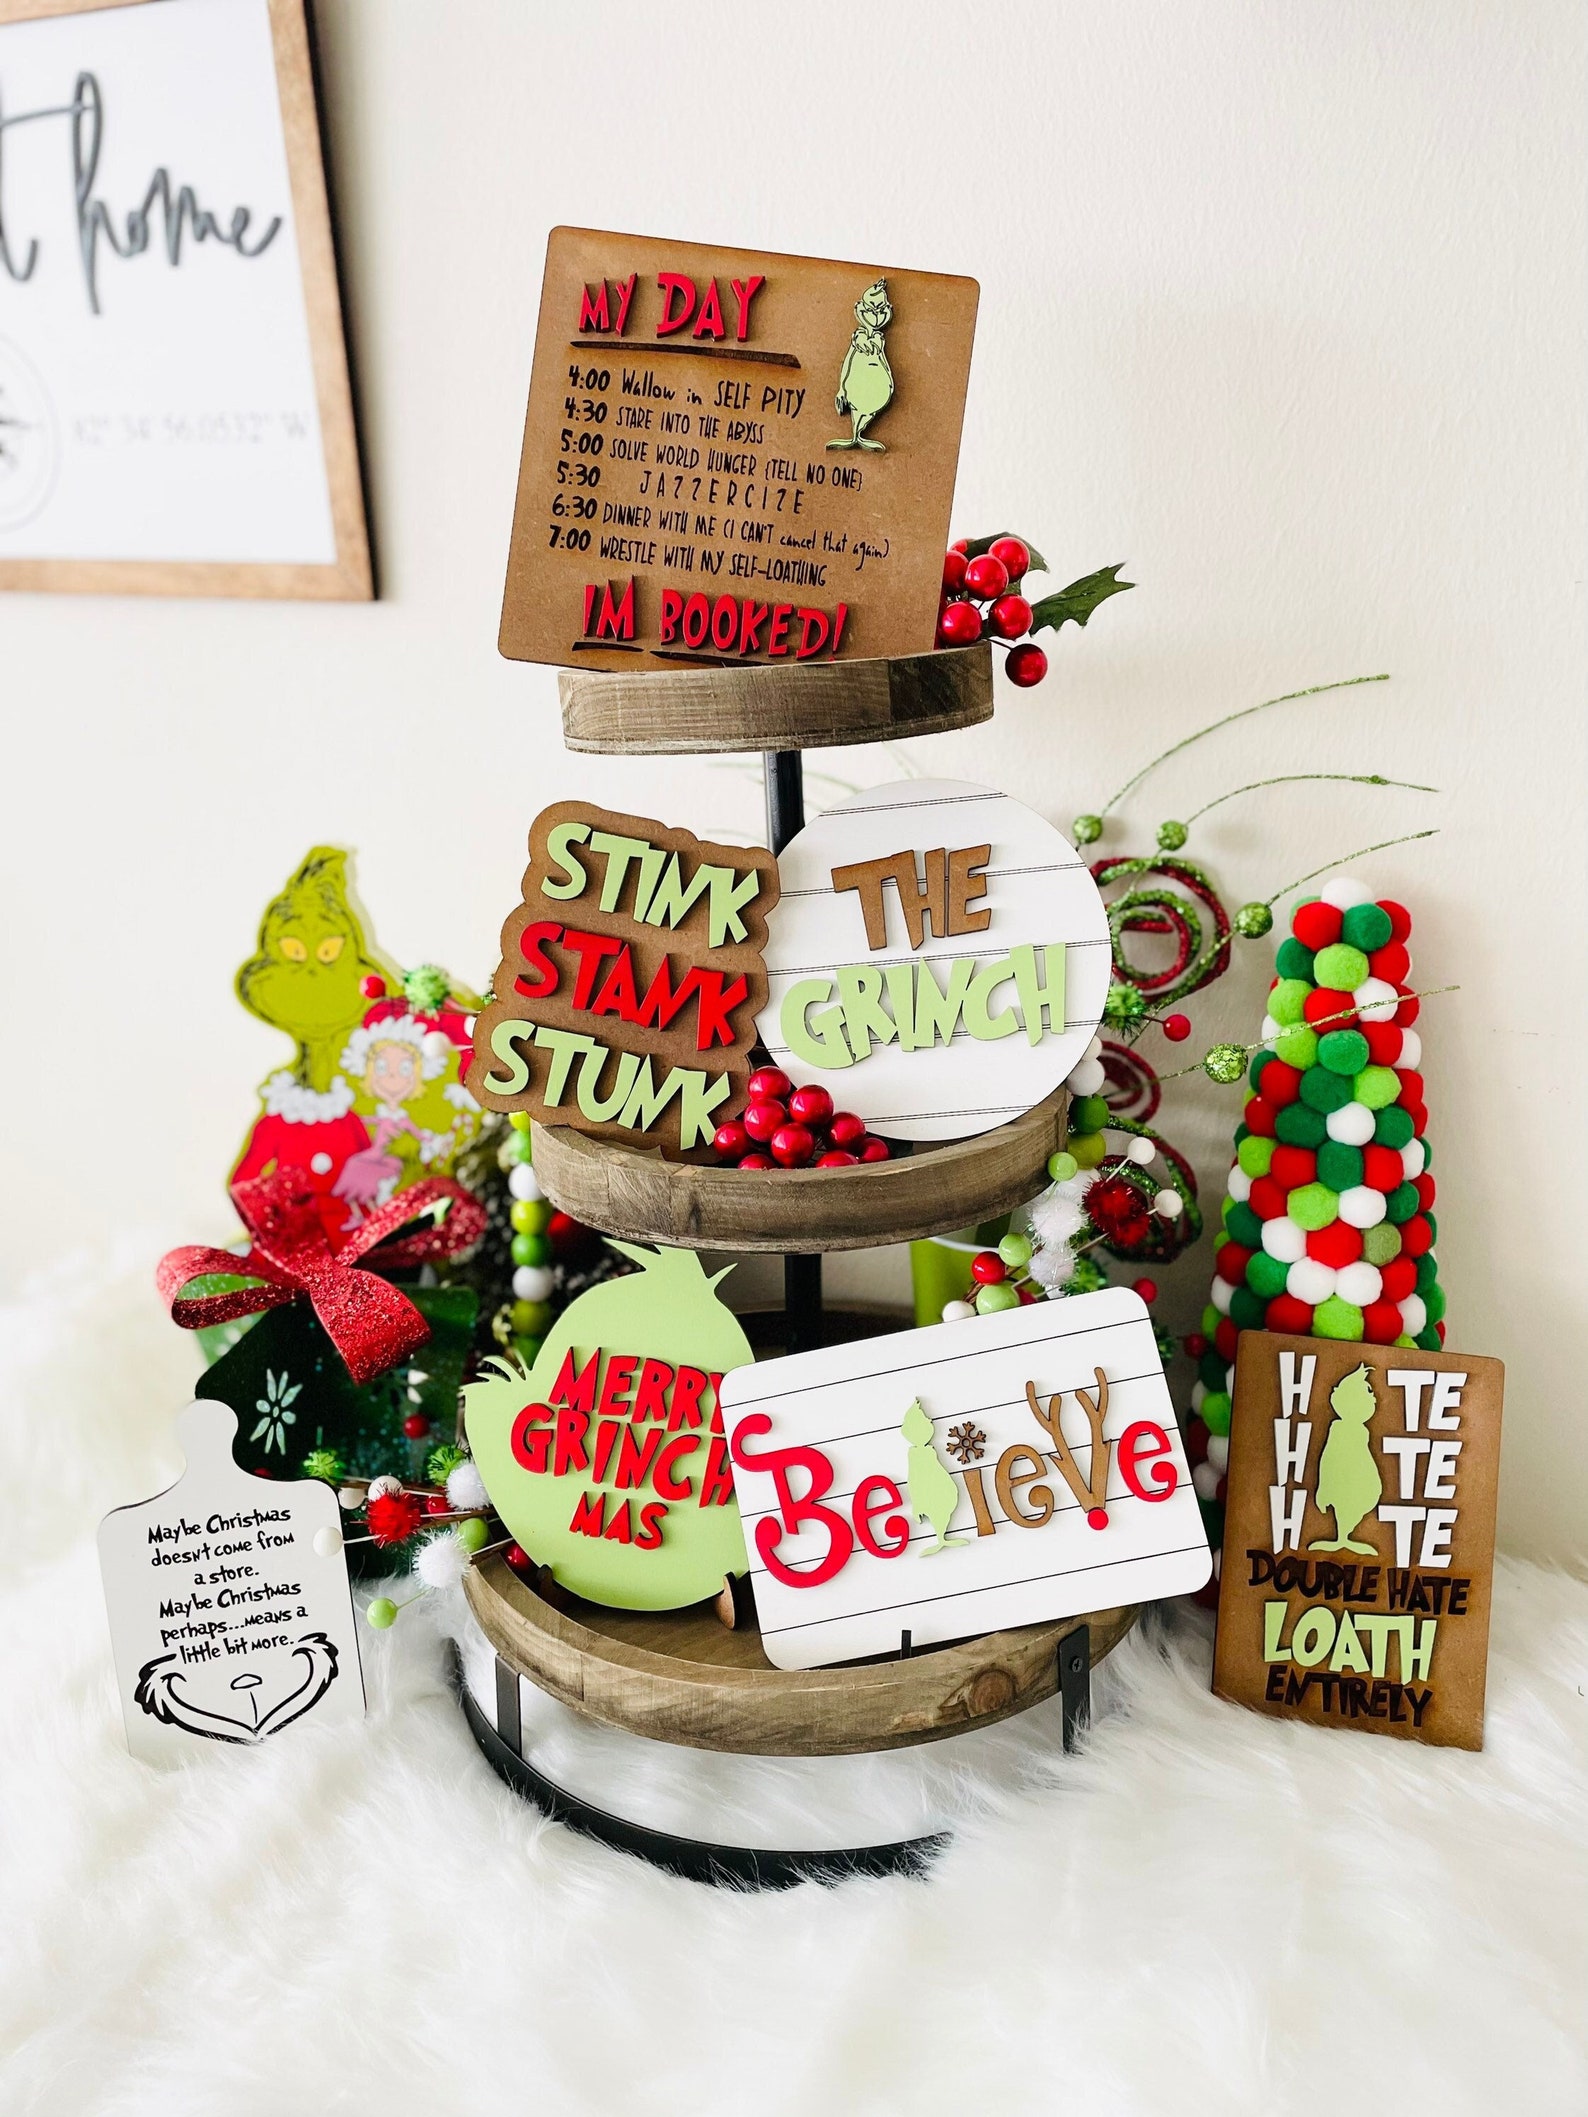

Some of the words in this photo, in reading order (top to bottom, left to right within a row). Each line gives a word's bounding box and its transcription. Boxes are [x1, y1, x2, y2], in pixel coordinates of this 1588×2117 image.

[72, 71, 282, 315] home
[579, 272, 638, 337] MY
[656, 272, 766, 342] DAY
[565, 397, 607, 423] 4:30
[616, 406, 653, 429] STARE
[660, 411, 690, 434] INTO
[699, 414, 721, 439] THE
[727, 420, 764, 444] ABYSS
[569, 365, 610, 391] 4:00
[622, 368, 675, 400] Wallow
[686, 388, 702, 405] in
[714, 380, 751, 409] SELF
[762, 386, 806, 419] PITY
[557, 460, 600, 487] 5:30
[561, 428, 603, 455] 5:00
[610, 439, 648, 462] SOLVE
[656, 444, 699, 469] WORLD
[707, 448, 757, 476] HUNGER
[807, 463, 825, 484] NO
[549, 524, 591, 551] 7:00
[600, 536, 657, 565] WRESTLE
[664, 545, 694, 572] WITH
[701, 550, 724, 575] MY
[729, 553, 827, 586] SELF-LOATHING
[552, 493, 597, 519] 6:30
[603, 502, 651, 528] DINNER
[659, 510, 688, 534] WITH
[695, 515, 717, 536] ME
[741, 521, 774, 543] CAN'T
[780, 529, 816, 549] cancel
[823, 531, 847, 552] that
[853, 538, 889, 571] again)
[583, 575, 635, 642] IM
[658, 588, 849, 661] BOOKED!
[541, 822, 759, 949] STINK
[831, 844, 992, 952] THE
[514, 920, 748, 1051] STANK
[780, 942, 1066, 1070] GRINCH
[483, 1019, 731, 1152] STUNK
[510, 1402, 735, 1509] GRINCH
[147, 1518, 202, 1544] Maybe
[206, 1508, 292, 1534] Christmas
[214, 1540, 253, 1557] come
[256, 1530, 295, 1551] from
[569, 1490, 669, 1551] MAS
[159, 1593, 213, 1619] Maybe
[216, 1582, 302, 1609] Christmas
[194, 1572, 207, 1585] a
[209, 1564, 260, 1585] store.
[1246, 1549, 1381, 1602] DOUBLE
[1387, 1567, 1471, 1616] HATE
[296, 1605, 309, 1618] a
[1264, 1601, 1438, 1686] LOATH
[179, 1641, 221, 1664] little
[223, 1637, 248, 1656] bit
[251, 1633, 294, 1652] more.
[1265, 1664, 1433, 1728] ENTIRELY
